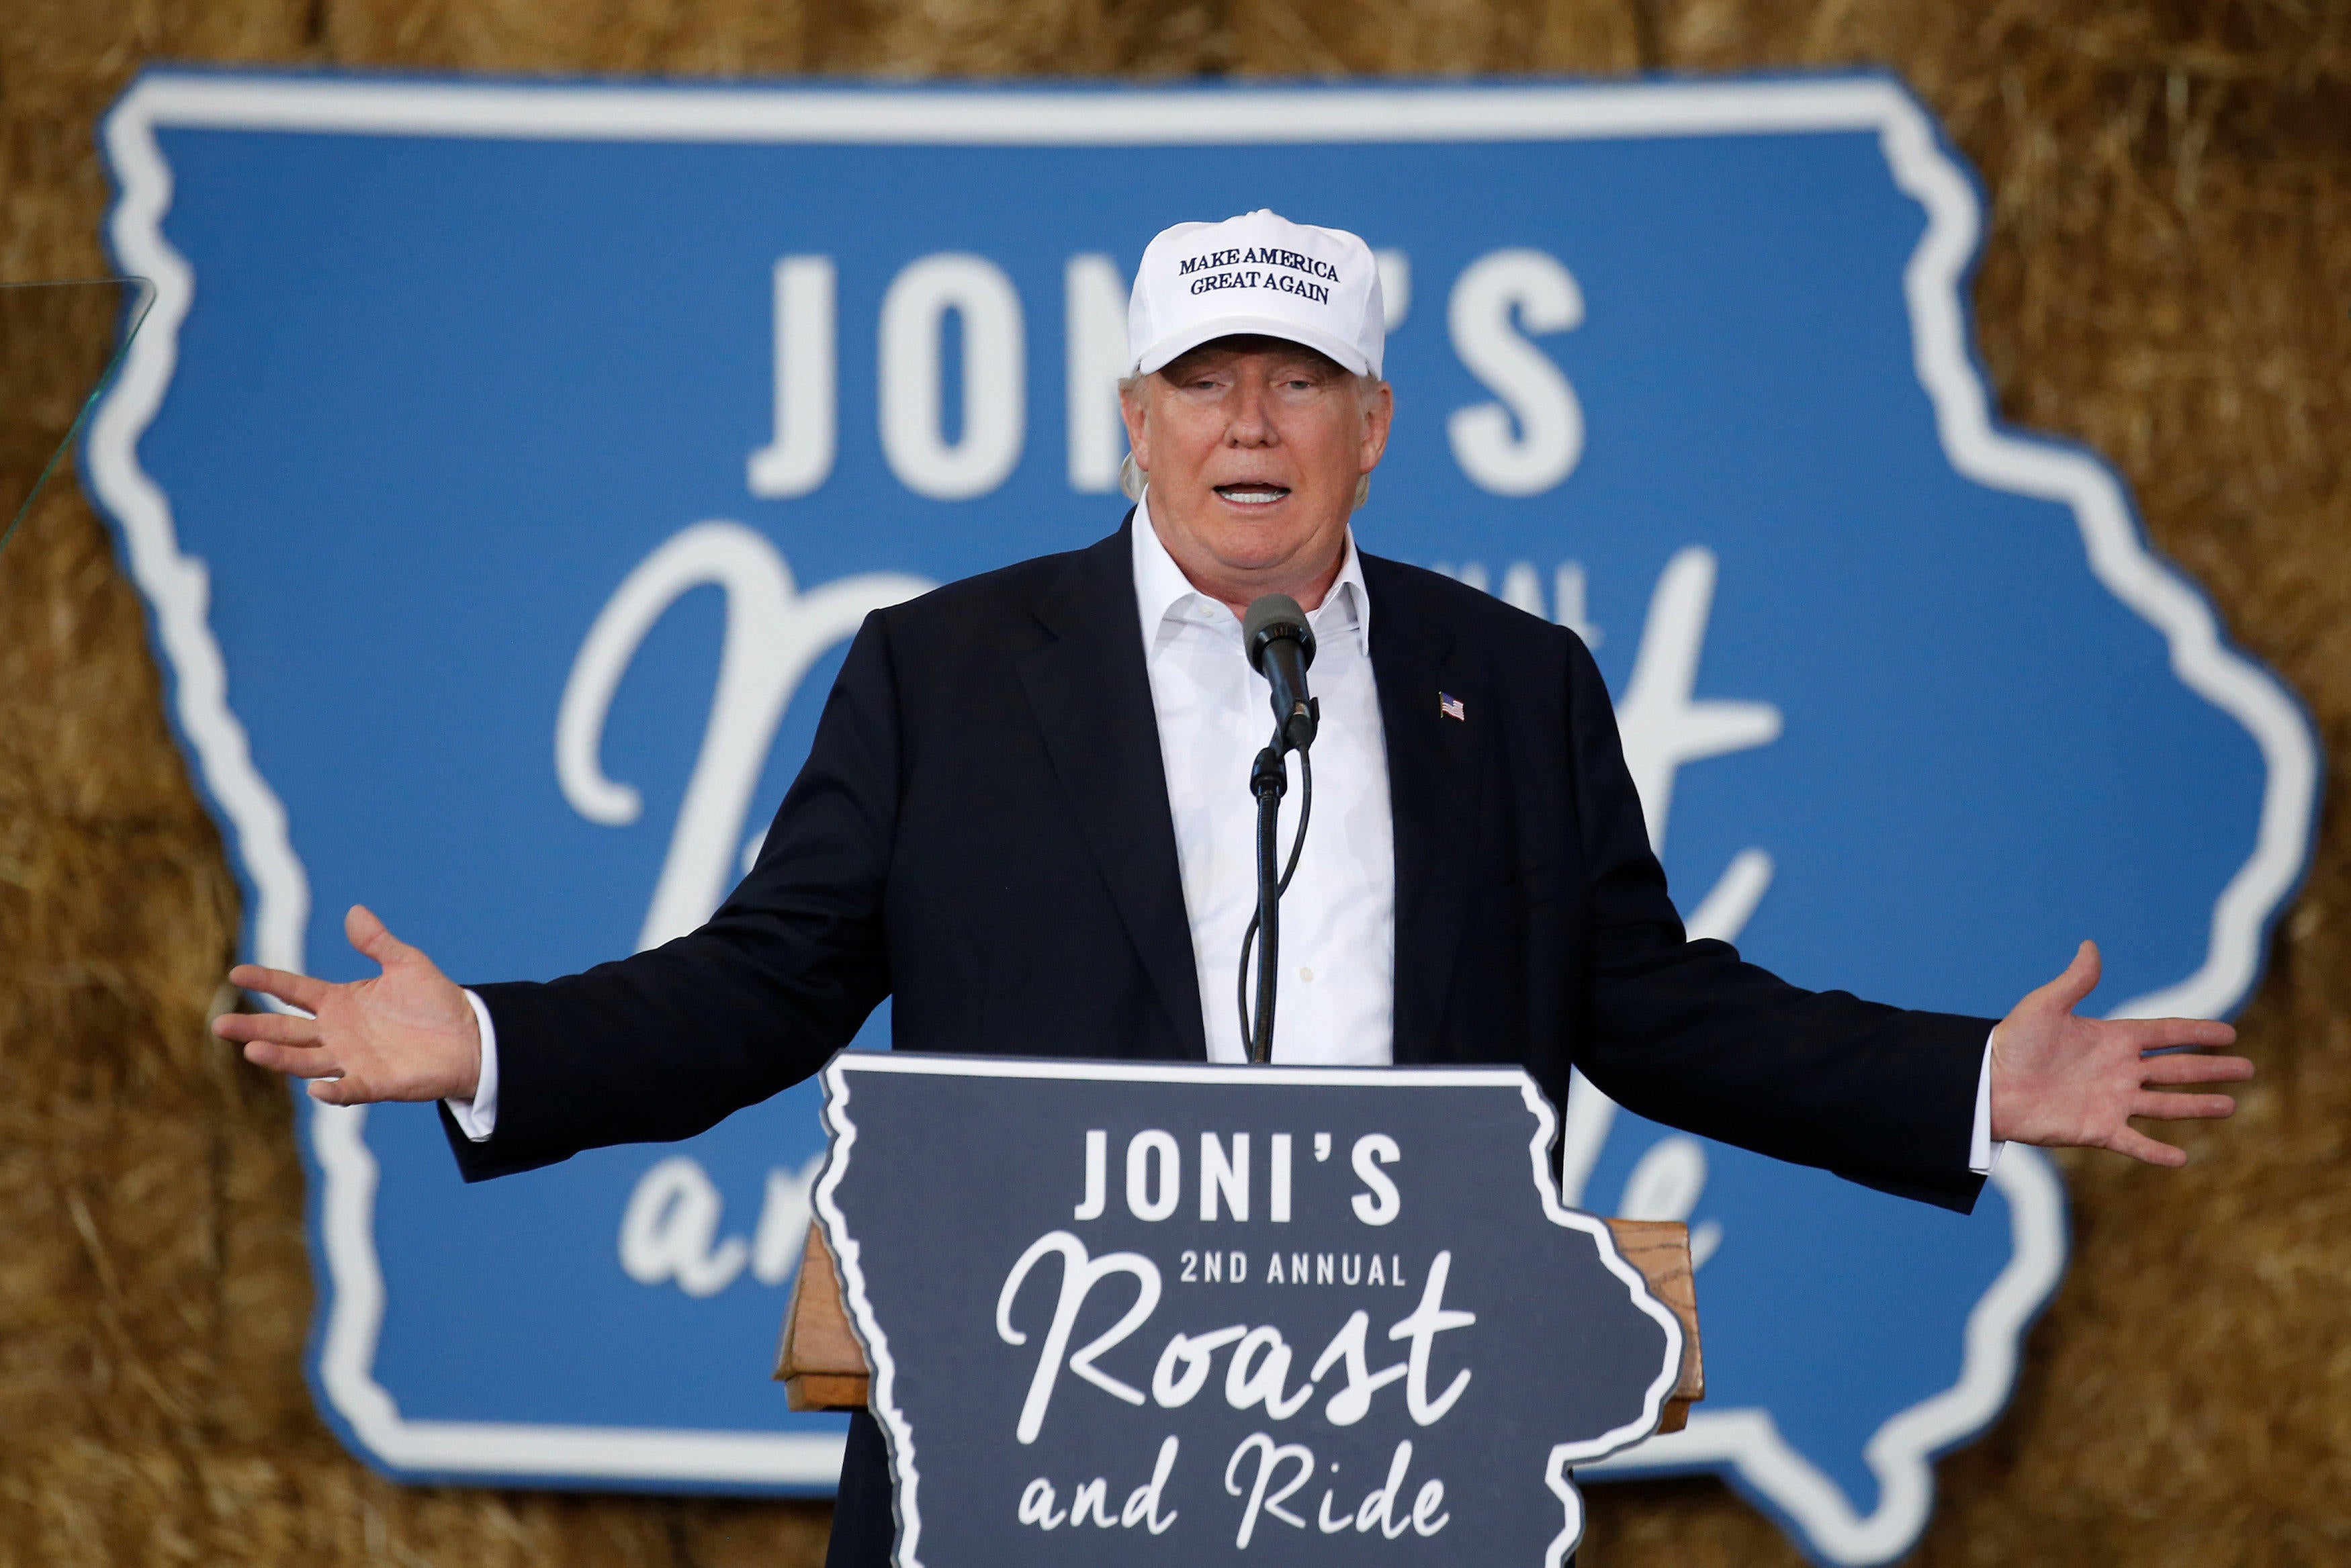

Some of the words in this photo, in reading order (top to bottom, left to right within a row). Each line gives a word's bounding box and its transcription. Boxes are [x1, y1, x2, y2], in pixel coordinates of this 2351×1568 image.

[1178, 247, 1240, 277] MAKE
[1243, 246, 1341, 283] AMERICA
[1190, 271, 1261, 296] GREAT
[1262, 272, 1330, 306] AGAIN
[747, 250, 1583, 496] JO'S
[1073, 1128, 1401, 1227] JONI'S
[1180, 1250, 1248, 1284] 2ND
[1266, 1251, 1406, 1287] ANNUAL
[995, 1230, 1477, 1445] Roast
[1017, 1434, 1180, 1536] and
[1224, 1432, 1450, 1550] Ride
